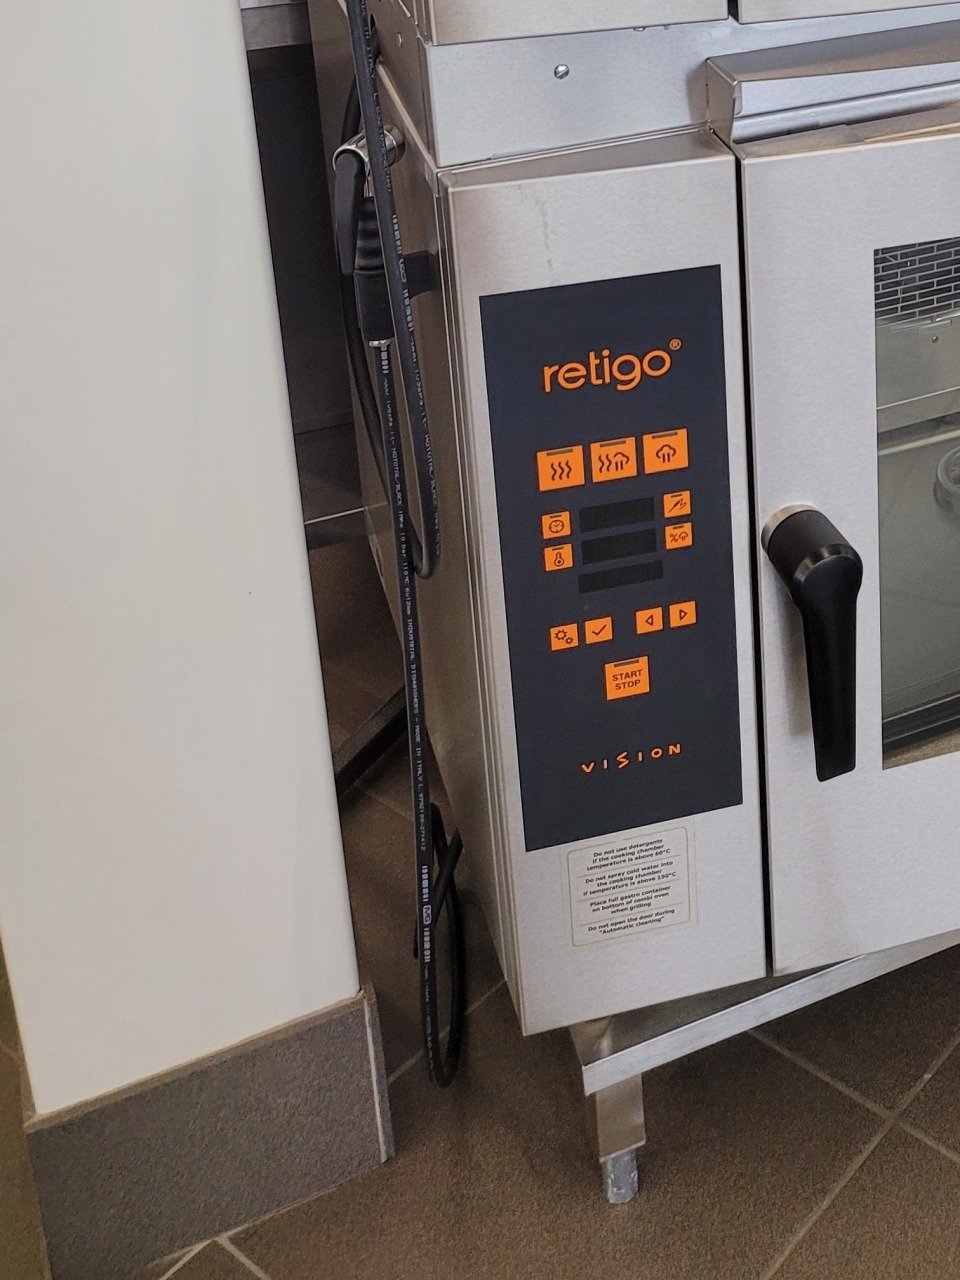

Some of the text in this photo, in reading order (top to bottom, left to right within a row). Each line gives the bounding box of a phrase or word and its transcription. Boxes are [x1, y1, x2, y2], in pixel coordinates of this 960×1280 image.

[611, 668, 643, 683] START
[614, 678, 642, 691] STOP
[580, 742, 683, 774] VISION
